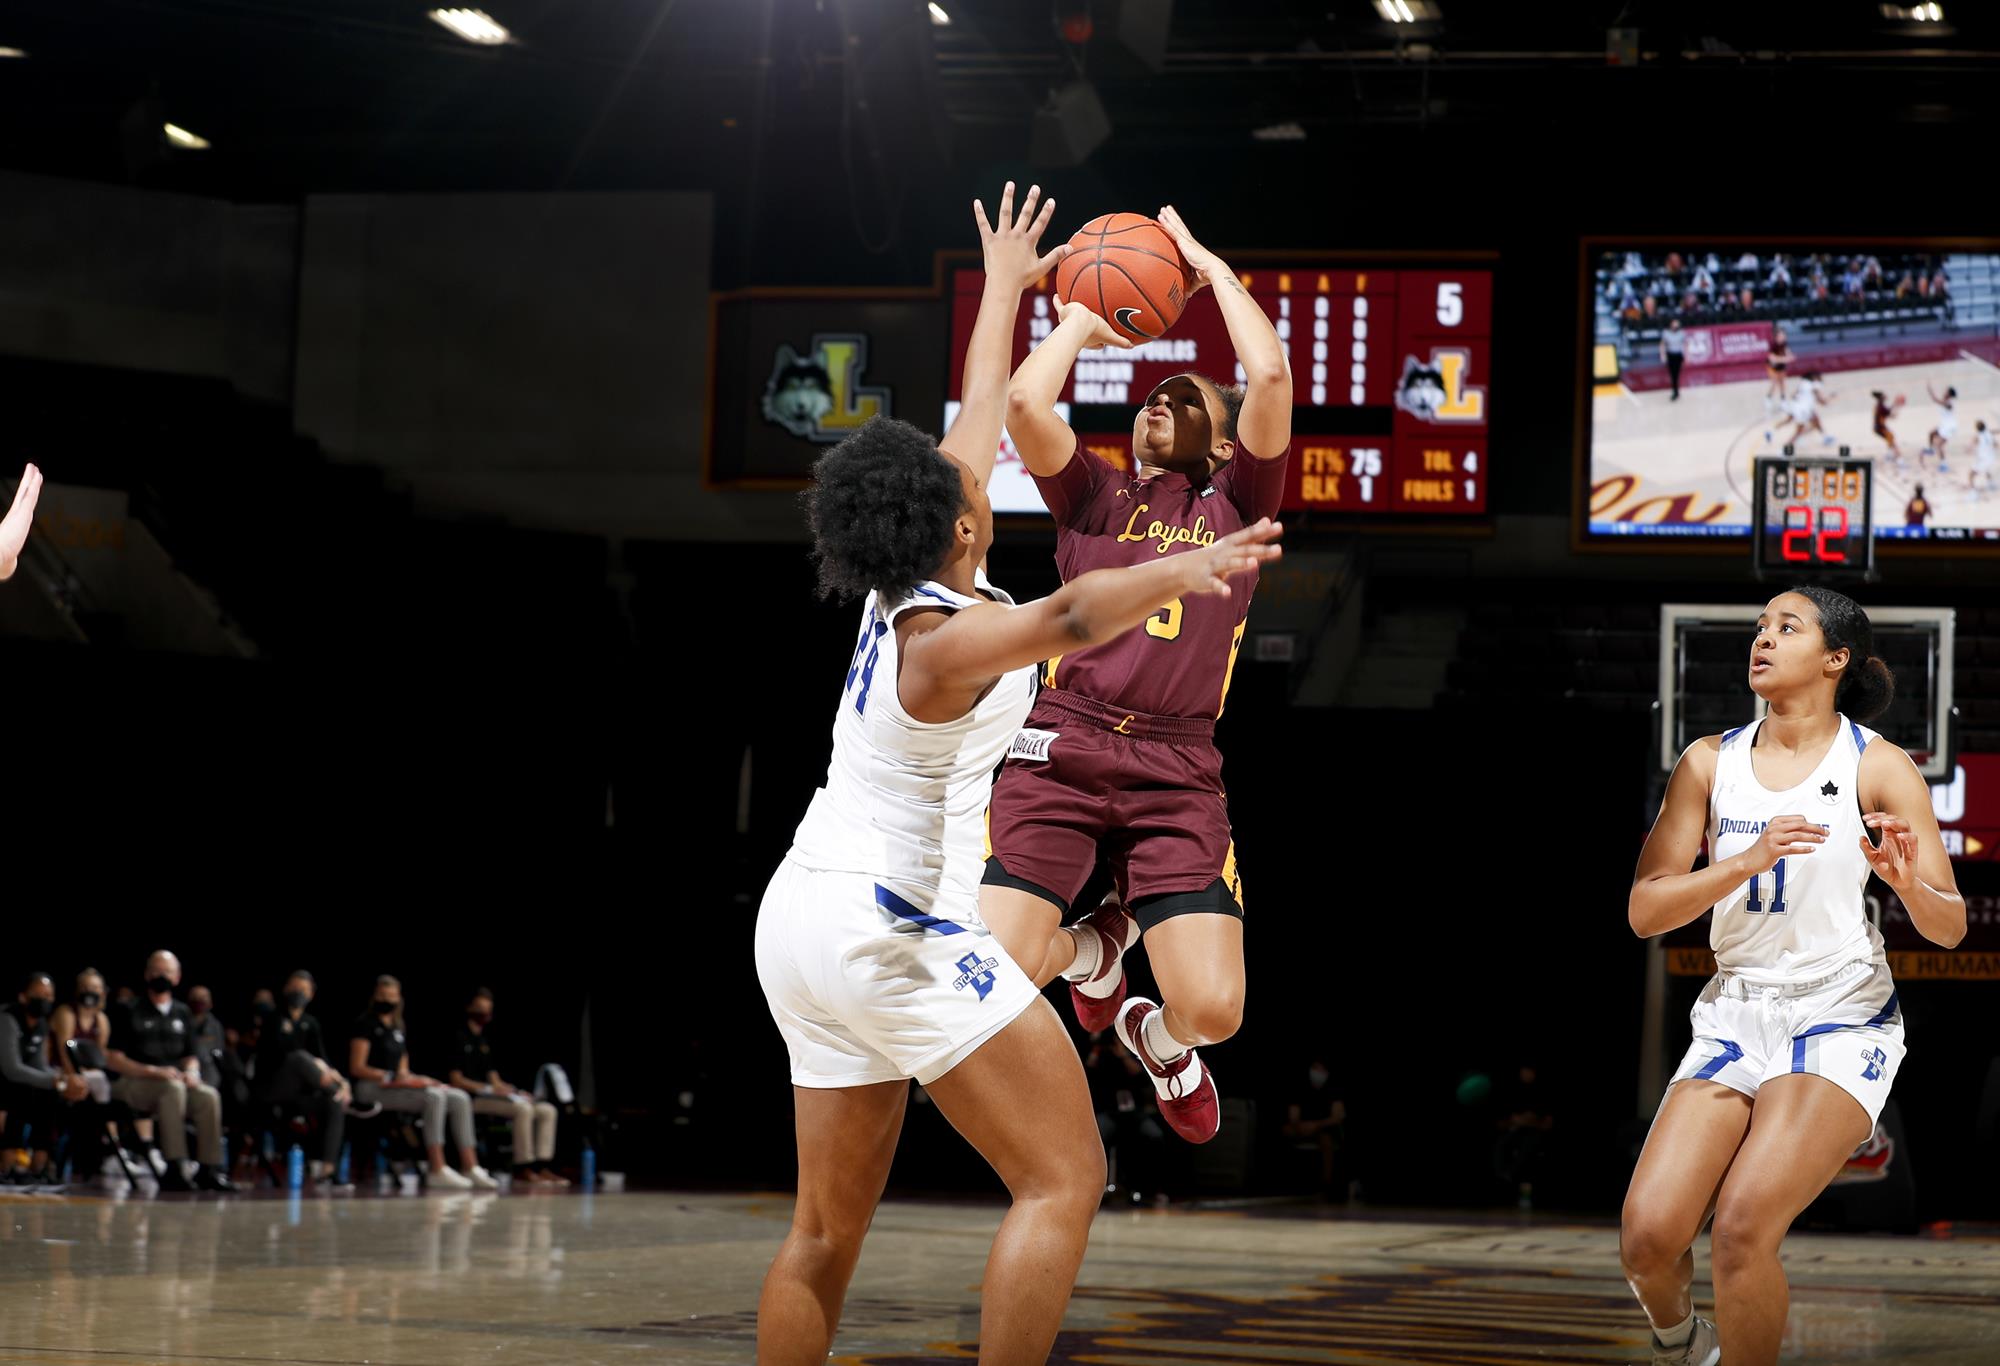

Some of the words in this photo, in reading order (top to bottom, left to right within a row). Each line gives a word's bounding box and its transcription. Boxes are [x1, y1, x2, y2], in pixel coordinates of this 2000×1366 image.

[1437, 282, 1462, 326] 5
[1303, 448, 1344, 474] FT%
[1350, 448, 1381, 476] 75
[1463, 451, 1477, 473] 4
[1302, 476, 1340, 500] BLK
[1358, 475, 1373, 502] 1
[1404, 480, 1454, 500] FOULS
[1464, 479, 1476, 501] 1
[1116, 504, 1216, 554] Loyola
[1782, 506, 1848, 561] 22
[1718, 818, 1769, 838] INDIAN
[1744, 857, 1788, 914] 11
